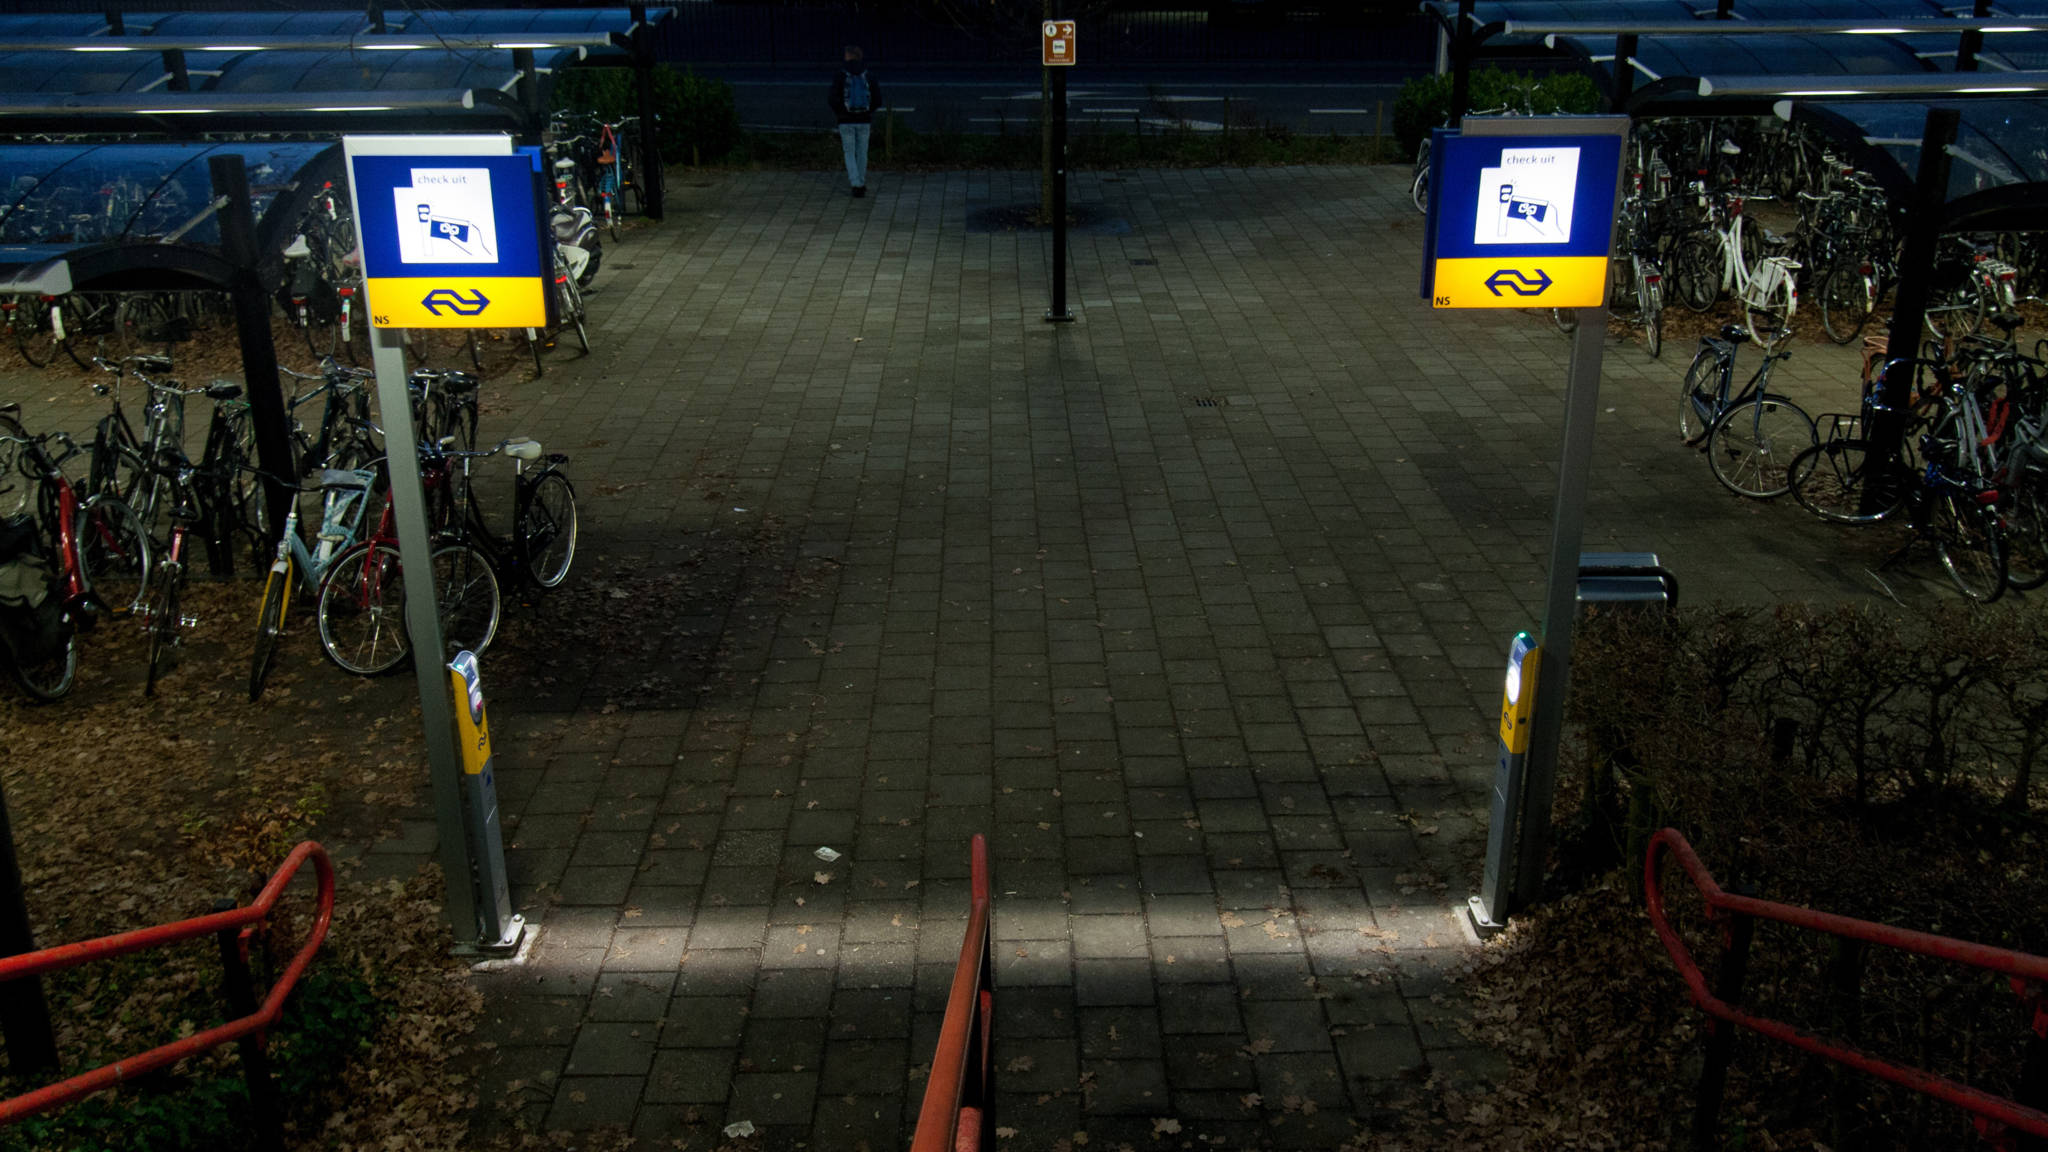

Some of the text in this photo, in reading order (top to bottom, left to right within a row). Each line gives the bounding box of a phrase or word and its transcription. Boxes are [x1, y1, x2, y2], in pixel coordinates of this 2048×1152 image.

[1507, 154, 1556, 164] check uit
[417, 175, 468, 185] check uit
[1435, 296, 1451, 306] NS
[374, 315, 390, 325] NS
